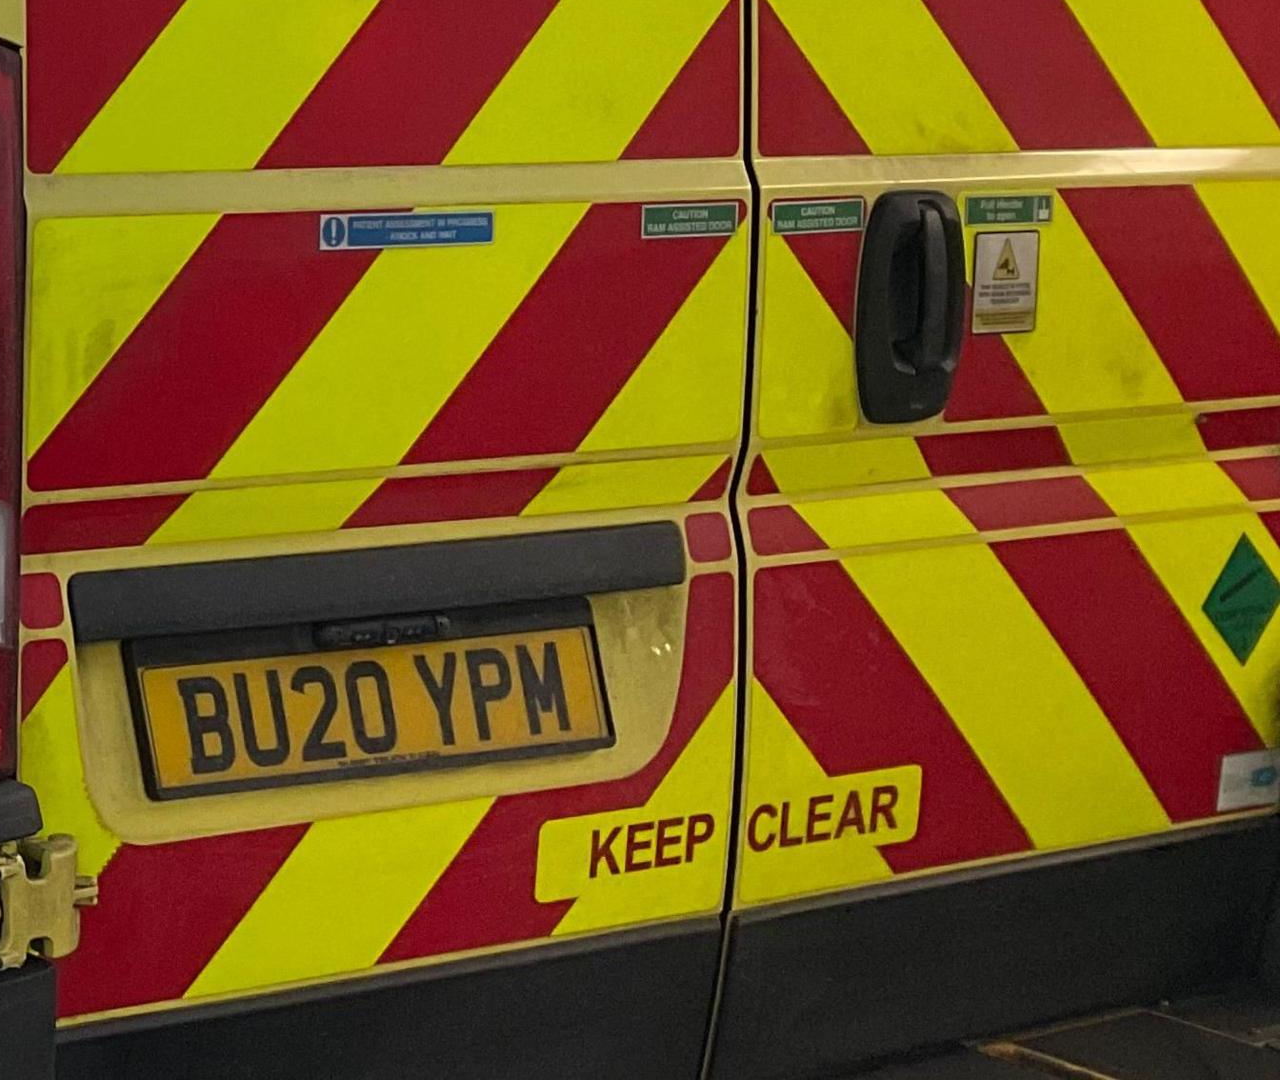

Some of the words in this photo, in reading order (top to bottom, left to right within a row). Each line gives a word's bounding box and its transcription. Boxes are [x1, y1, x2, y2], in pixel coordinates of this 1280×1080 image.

[177, 660, 395, 776] BU20
[414, 641, 572, 747] YPM
[588, 812, 715, 878] KEEP
[747, 783, 899, 853] CLEAR
